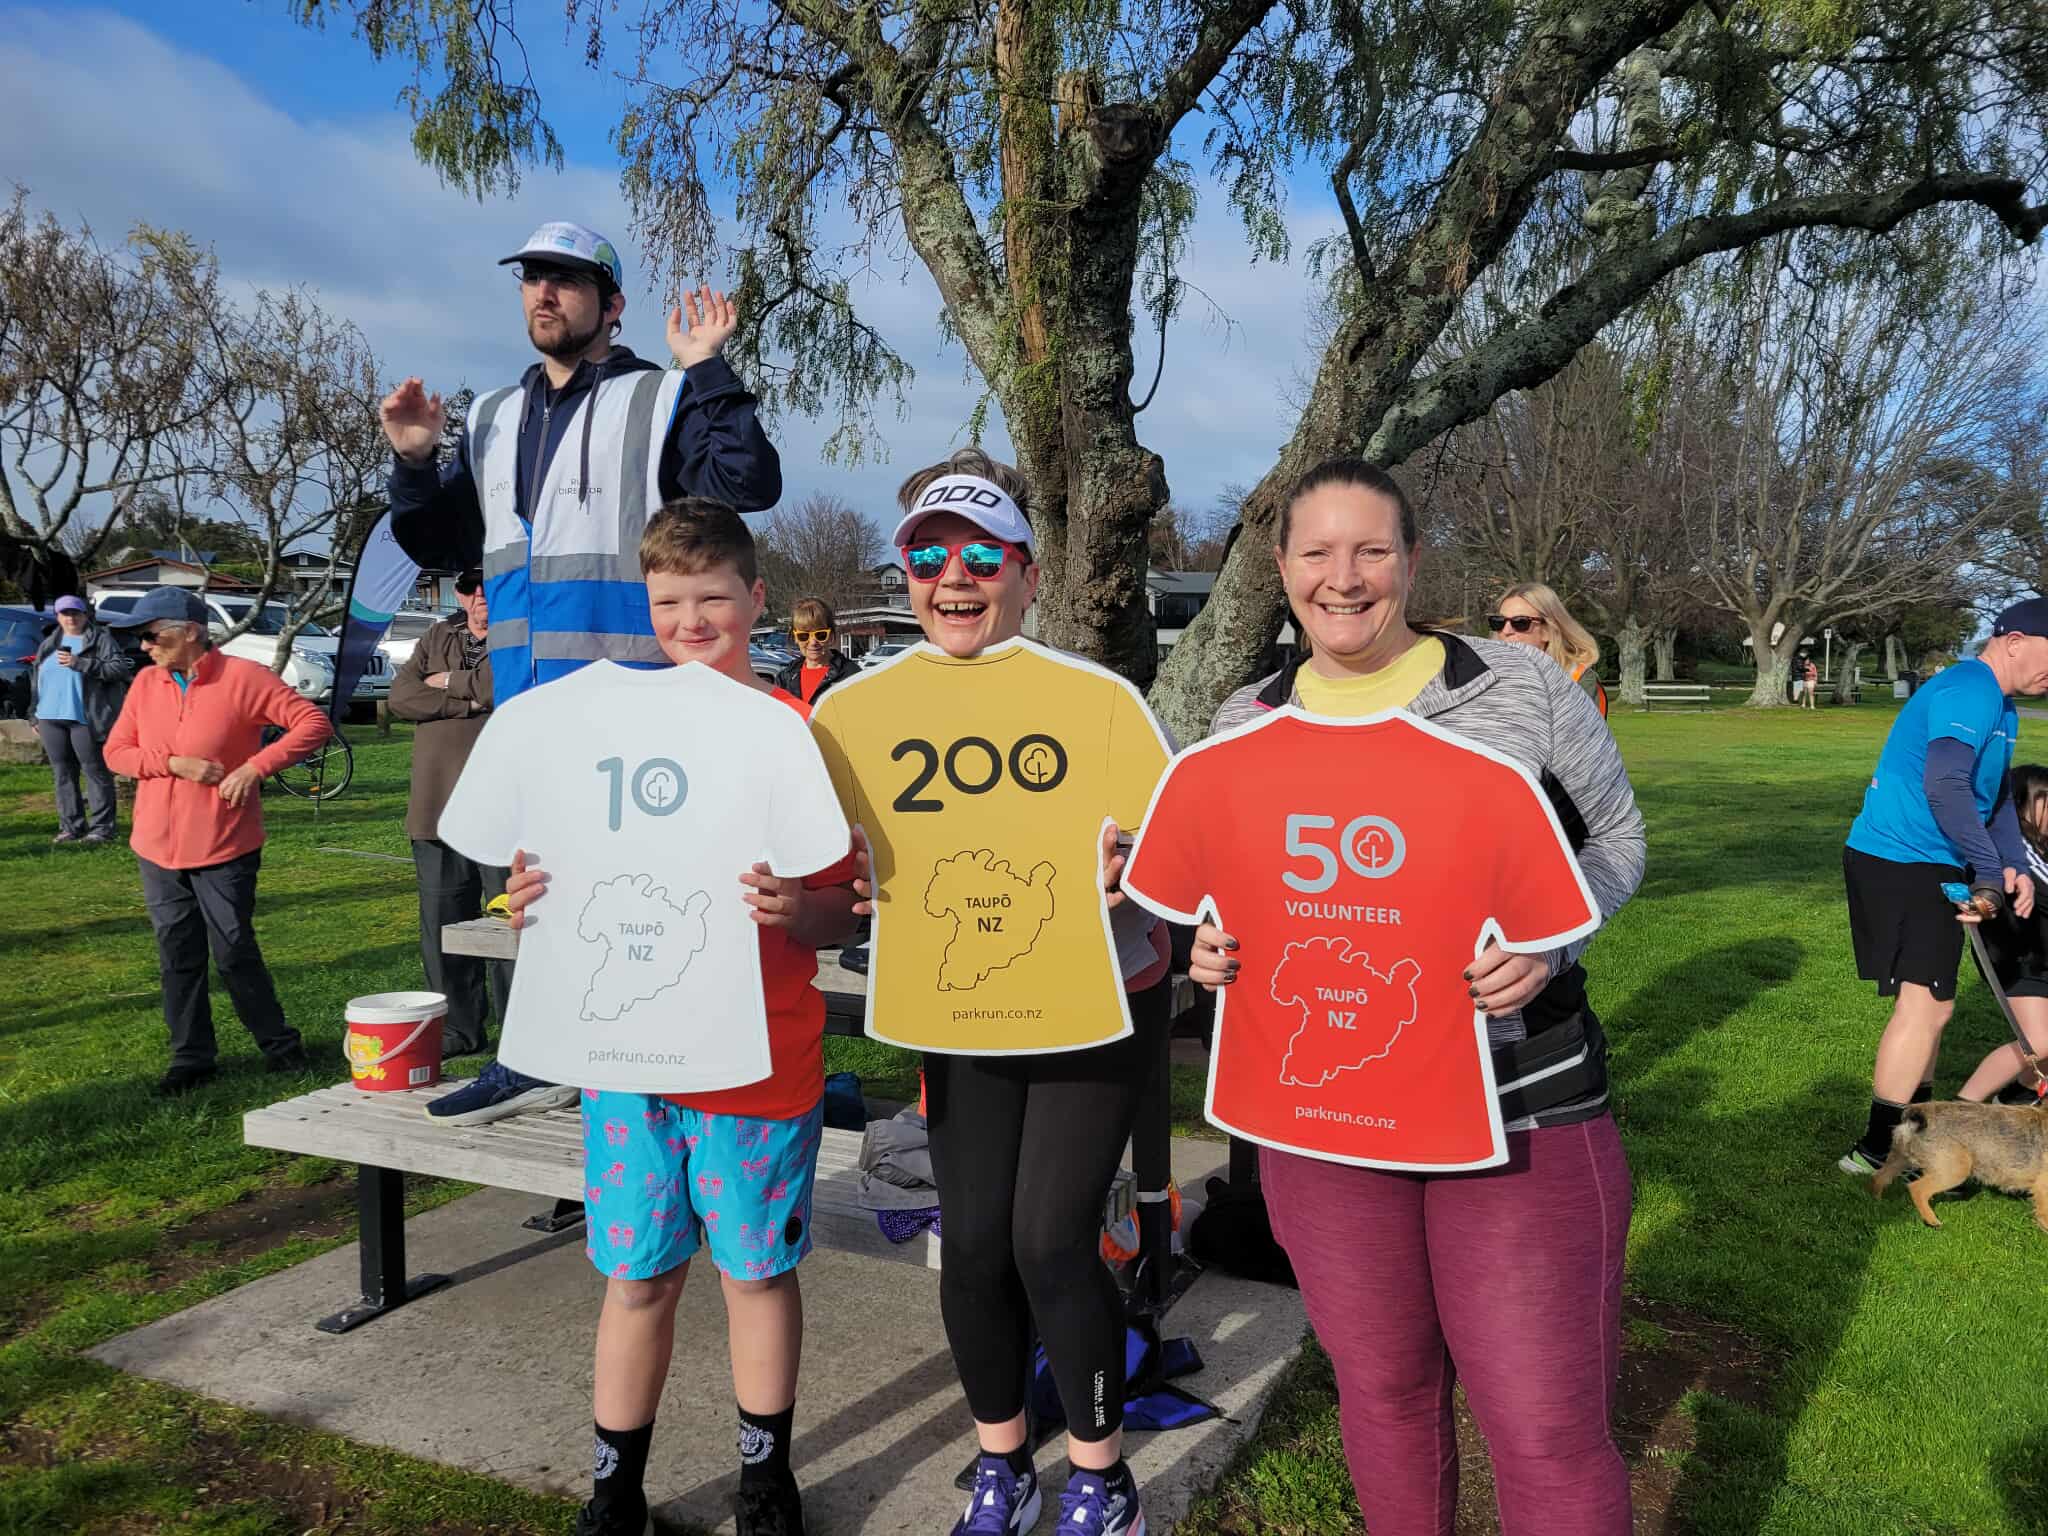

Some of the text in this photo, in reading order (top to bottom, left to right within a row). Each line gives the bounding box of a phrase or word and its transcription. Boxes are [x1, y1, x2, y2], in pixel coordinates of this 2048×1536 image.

[890, 733, 1069, 813] 200
[595, 756, 689, 833] 10
[1281, 813, 1407, 894] 50
[964, 893, 1012, 909] TAUPŌ
[1284, 900, 1402, 926] VOLUNTEER
[617, 920, 665, 937] TAUPŌ
[977, 916, 1004, 933] NZ
[627, 944, 654, 962] NZ
[1314, 987, 1368, 1005] TAUPŌ
[952, 1007, 1043, 1023] parkrun.co.nz
[1327, 1010, 1357, 1030] NZ
[588, 1047, 686, 1066] parkrun.co.nz
[1295, 1105, 1396, 1130] parkrun.co.nz
